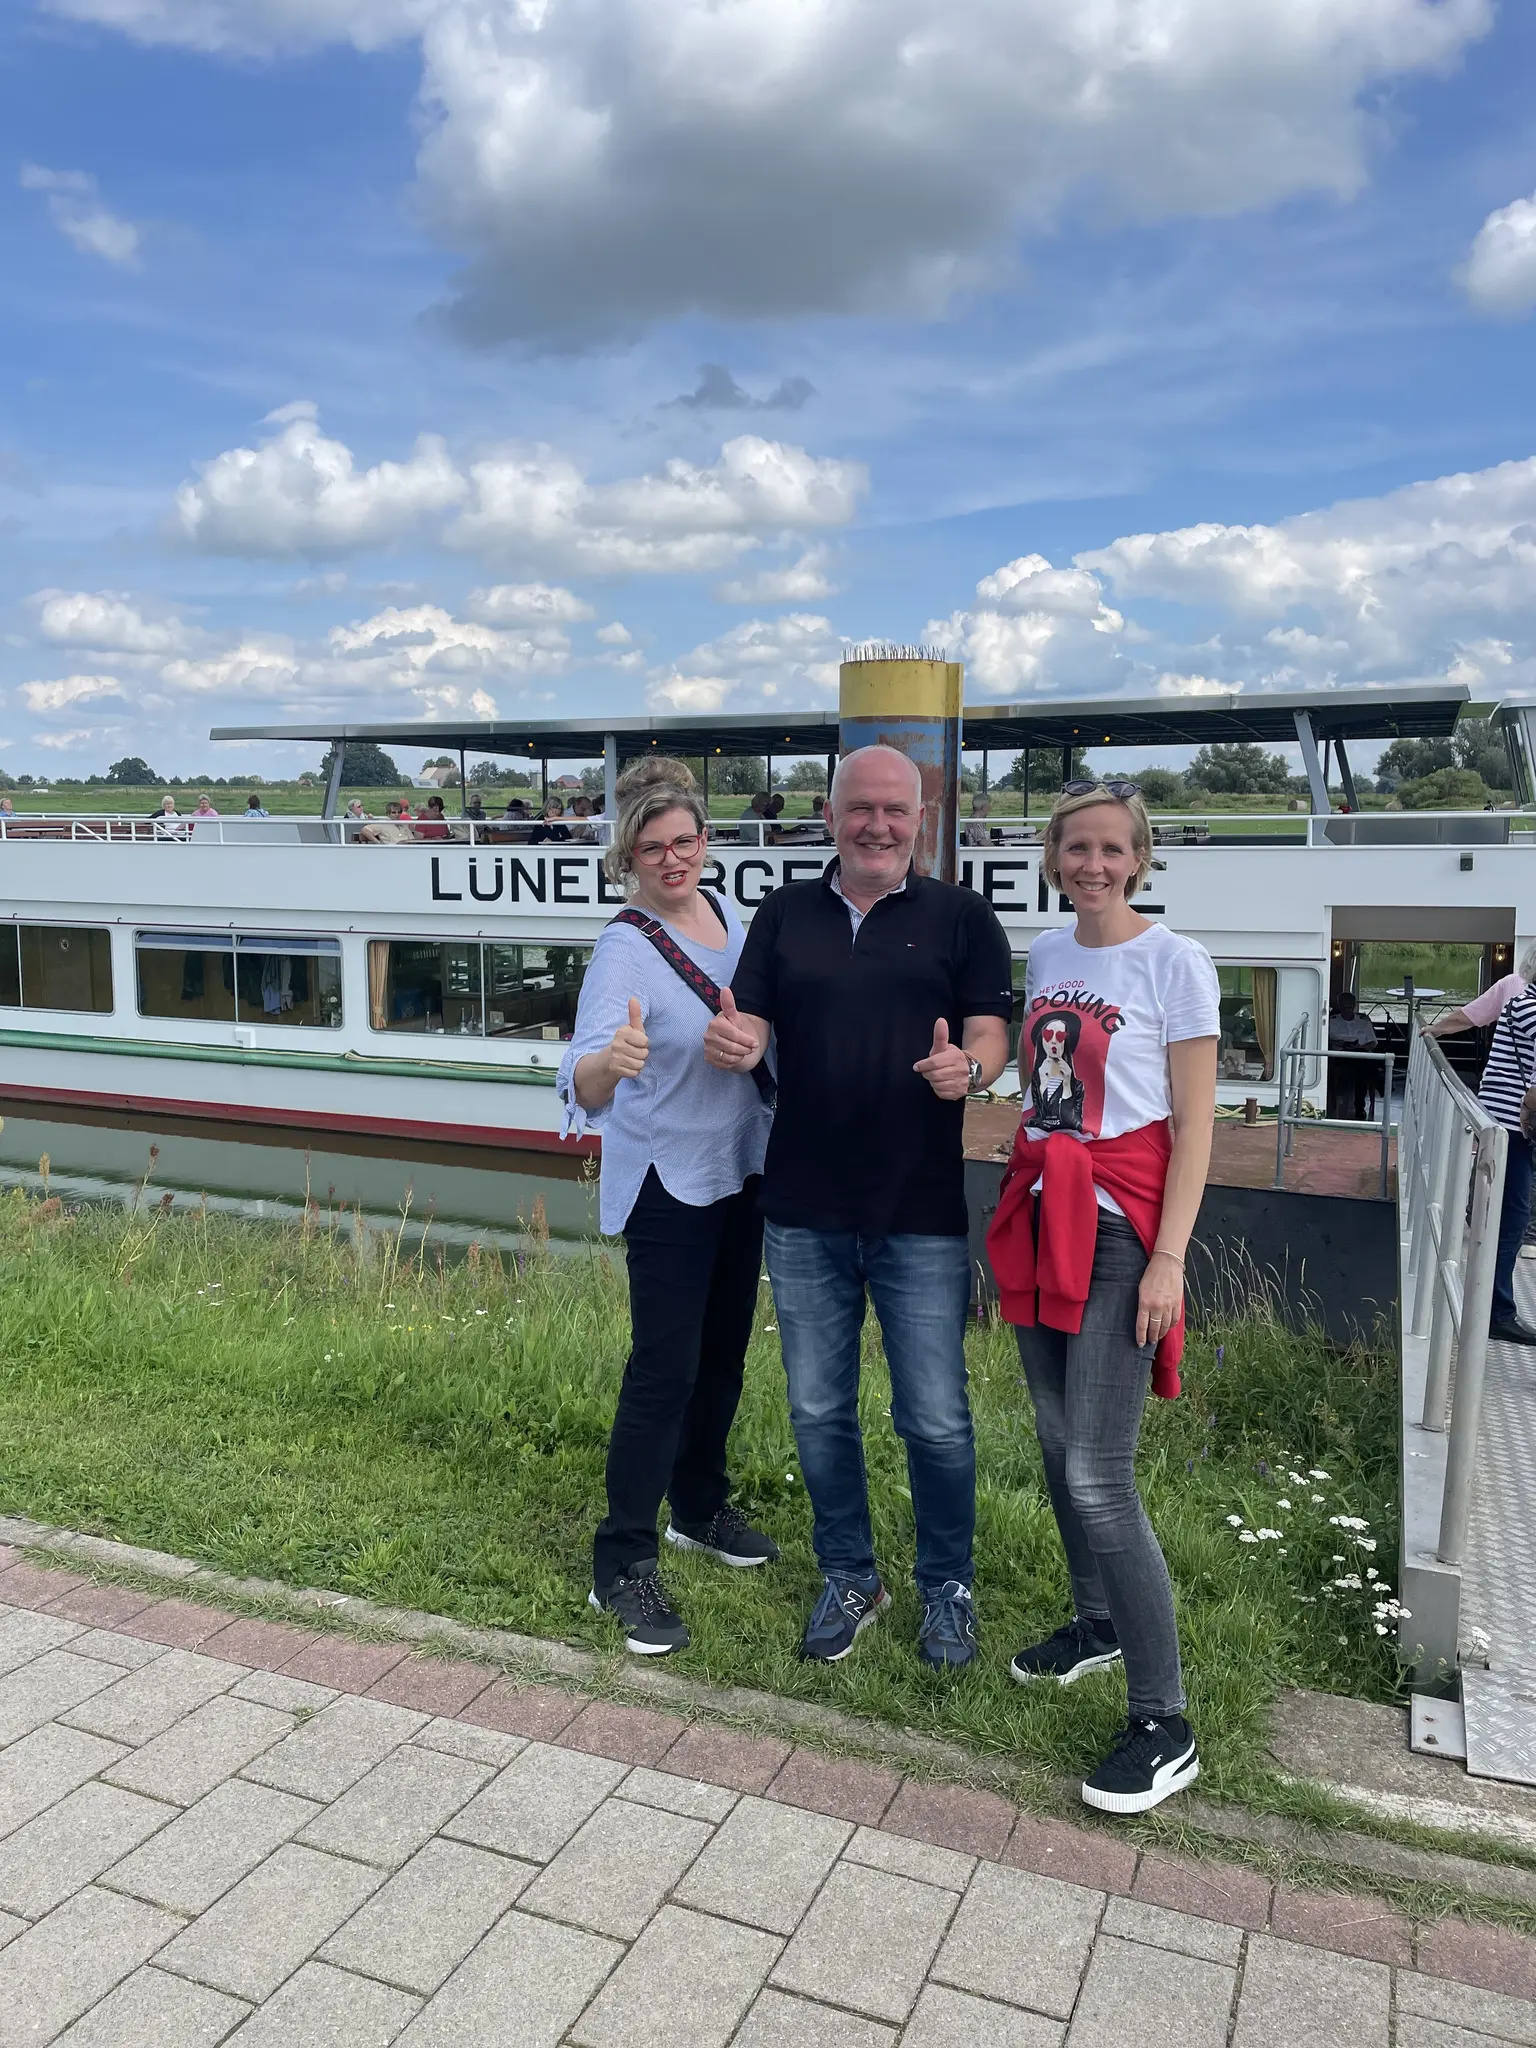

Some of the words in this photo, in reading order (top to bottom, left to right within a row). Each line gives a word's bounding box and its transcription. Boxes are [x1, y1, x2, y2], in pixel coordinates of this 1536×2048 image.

[1039, 984, 1057, 995] HEY
[1058, 980, 1085, 990] GOOD
[1032, 989, 1127, 1035] OOKING
